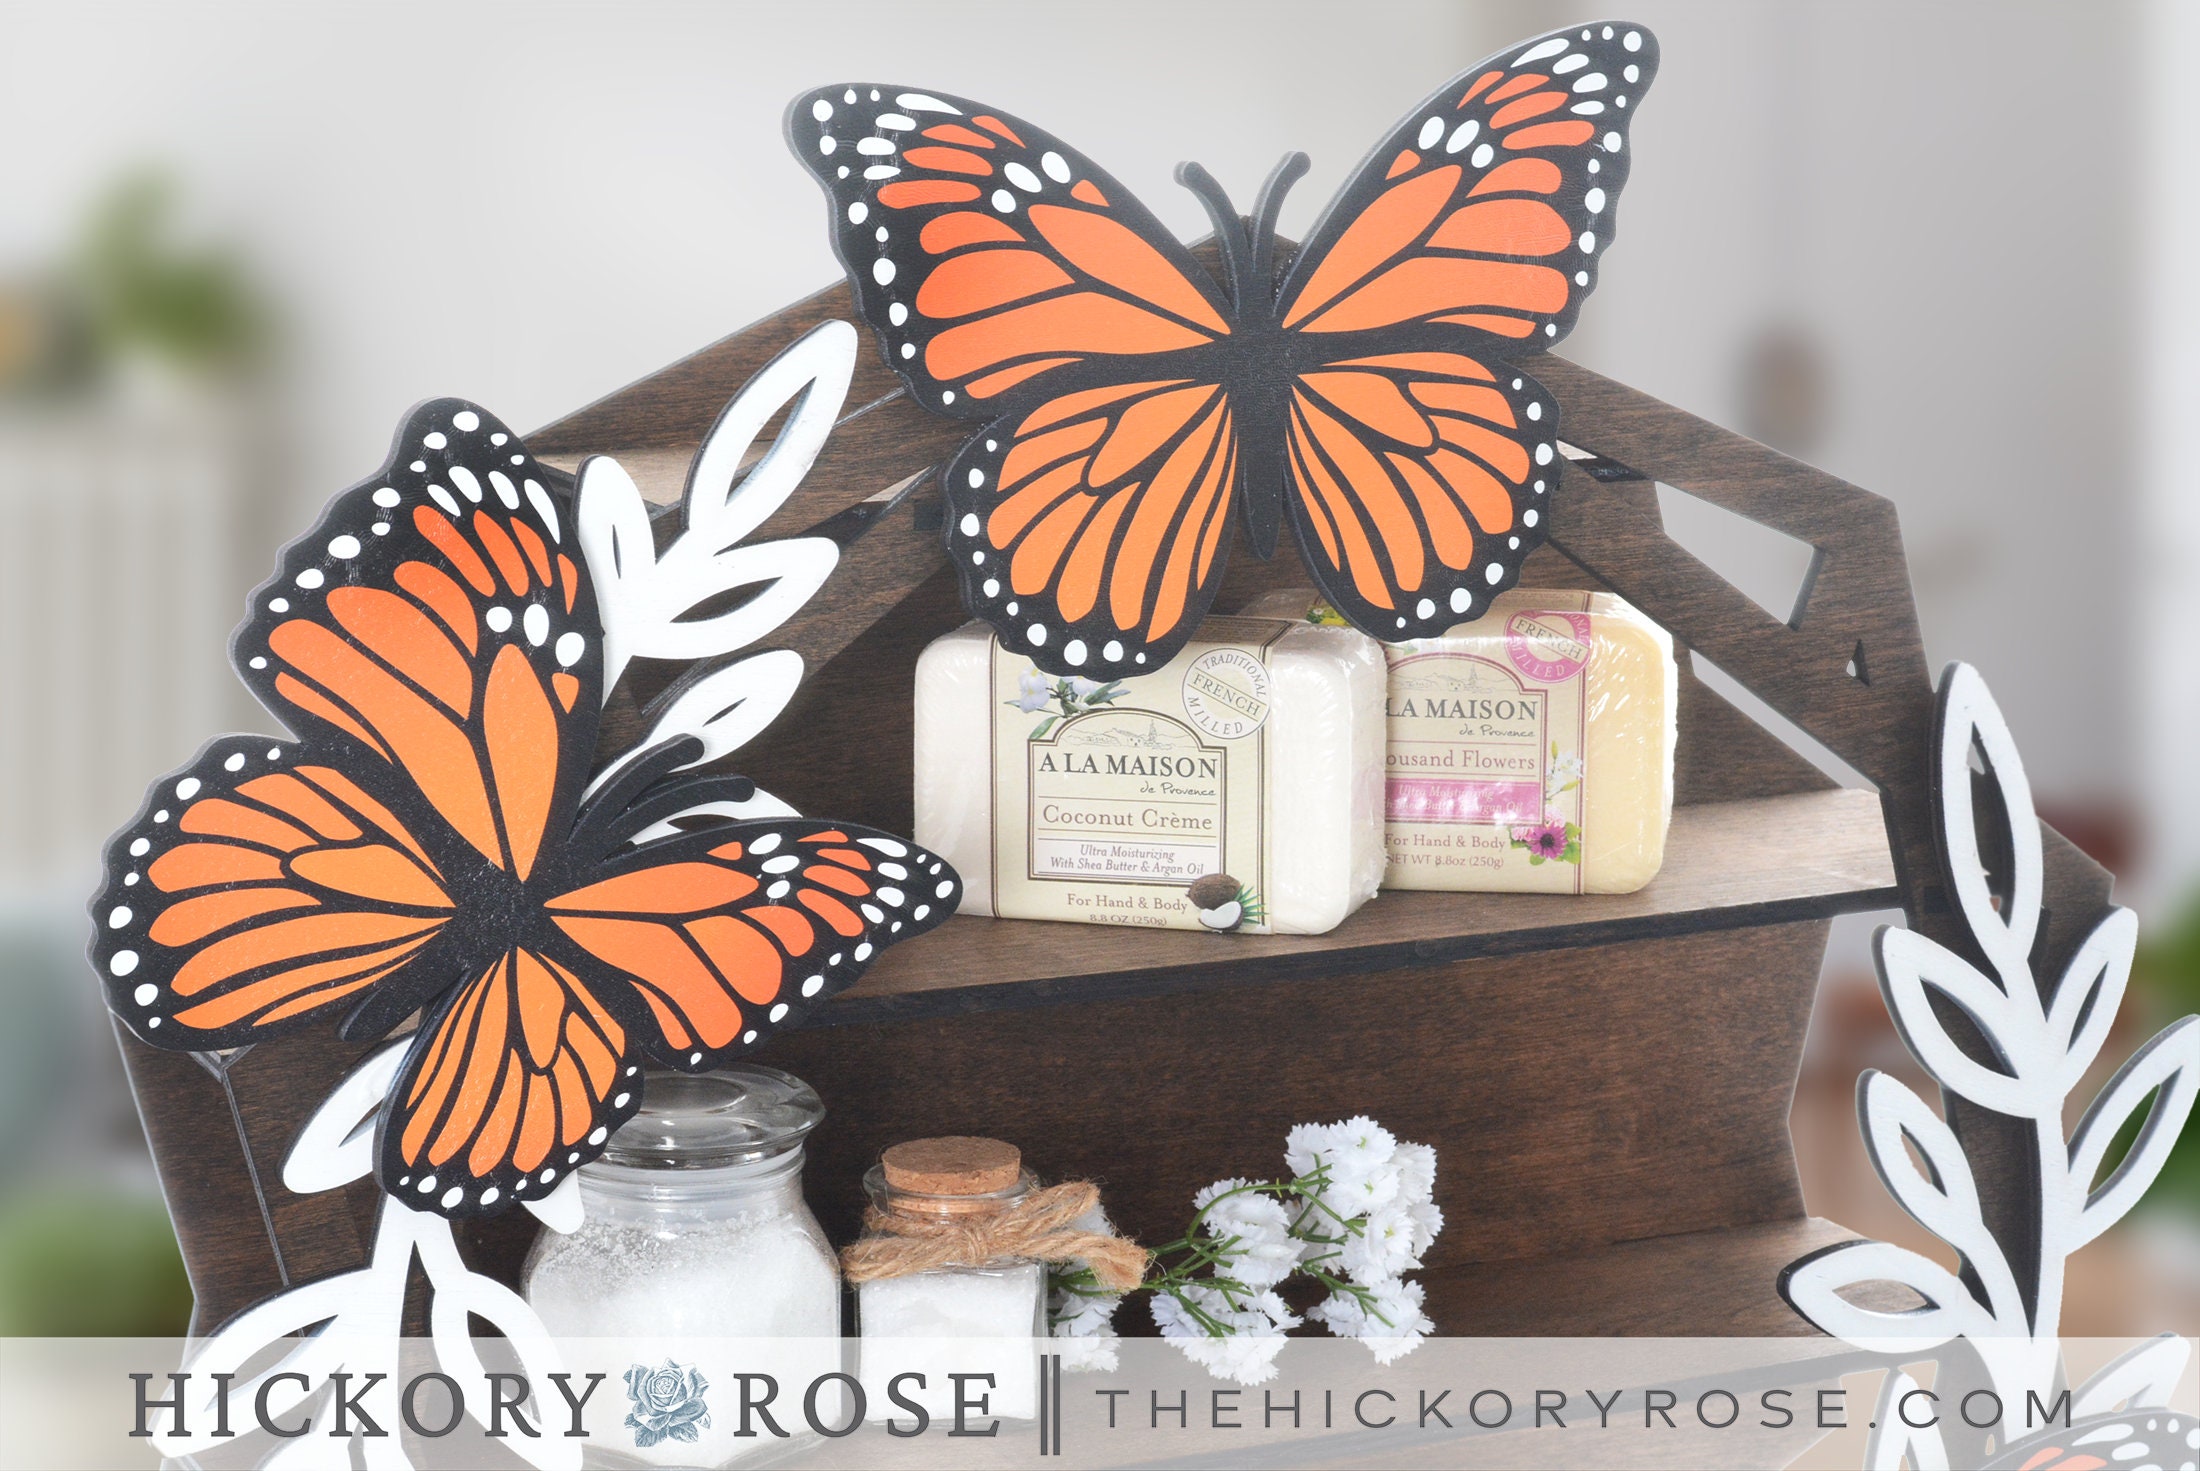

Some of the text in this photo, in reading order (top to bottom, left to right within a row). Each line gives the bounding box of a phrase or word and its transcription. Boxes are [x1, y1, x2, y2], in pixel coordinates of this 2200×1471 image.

[1516, 619, 1581, 659] FRENCH
[1202, 653, 1266, 697] TRADITIONAL
[1193, 673, 1260, 715] FRENCH
[1187, 696, 1243, 734] MILLED
[1425, 699, 1538, 720] MAISON
[1459, 723, 1536, 738] de Provence
[1038, 752, 1218, 779] A LA MAISON
[1386, 750, 1535, 769] ousand Flowers
[1140, 781, 1216, 796] de Provence
[1043, 805, 1213, 830] Coconut Crème
[1385, 833, 1506, 852] For Hand & Body
[1080, 844, 1175, 863] Ultra Moisturizing
[1411, 854, 1432, 865] WT
[1469, 856, 1504, 869] (250g)
[1050, 857, 1204, 876] With Shea Butter & Argan Oil
[1067, 893, 1187, 914] For Hand & Body
[1090, 914, 1167, 927] 8.8 OZ (250g)
